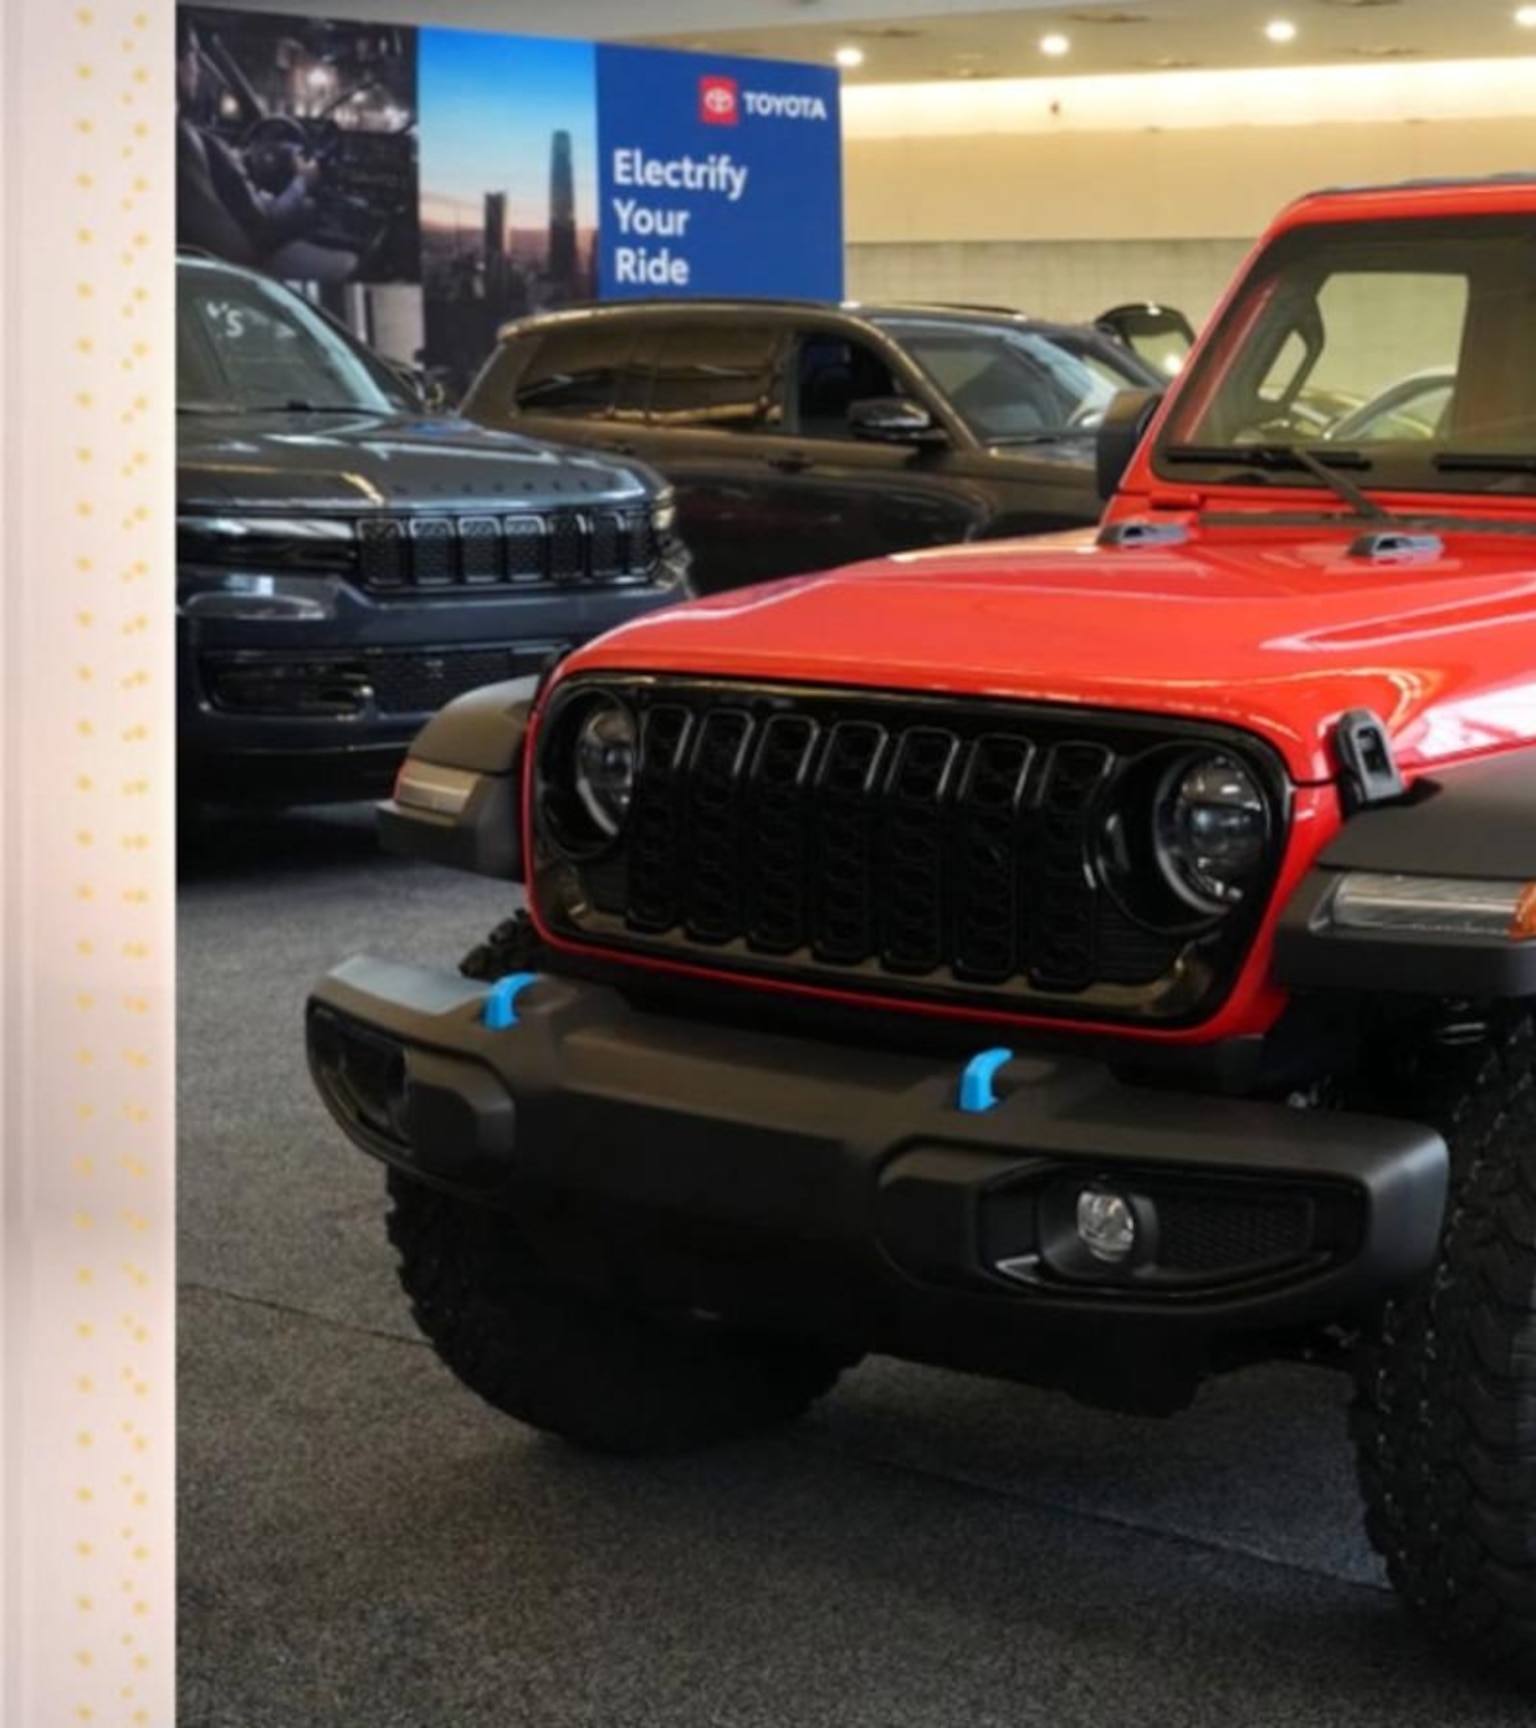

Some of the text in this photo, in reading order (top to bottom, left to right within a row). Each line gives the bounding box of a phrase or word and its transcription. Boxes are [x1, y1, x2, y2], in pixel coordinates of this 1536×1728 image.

[743, 91, 827, 120] TOYOTA
[613, 148, 748, 201] Electrify
[612, 198, 690, 237] Your
[615, 246, 689, 285] Ride
